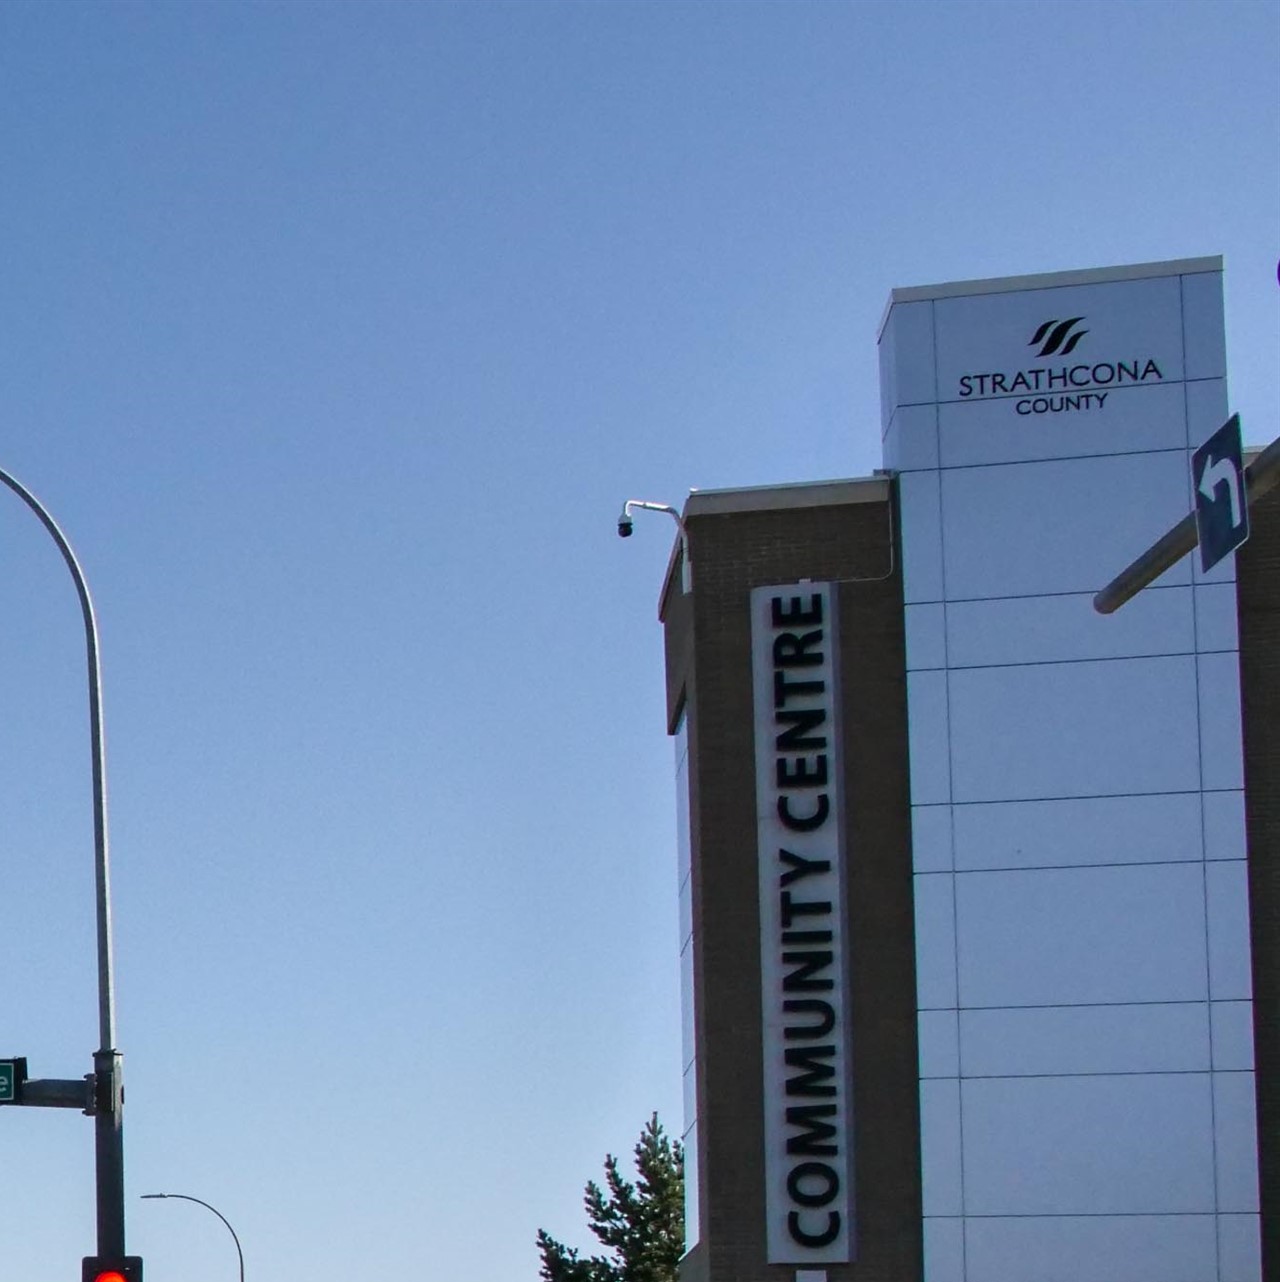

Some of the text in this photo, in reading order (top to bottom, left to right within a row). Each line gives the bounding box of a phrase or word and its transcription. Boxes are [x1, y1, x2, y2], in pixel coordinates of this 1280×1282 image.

[959, 359, 1163, 396] STRATHCONA
[1016, 393, 1109, 415] COUNTY
[771, 592, 841, 1250] COMMUNITY CENTRE
